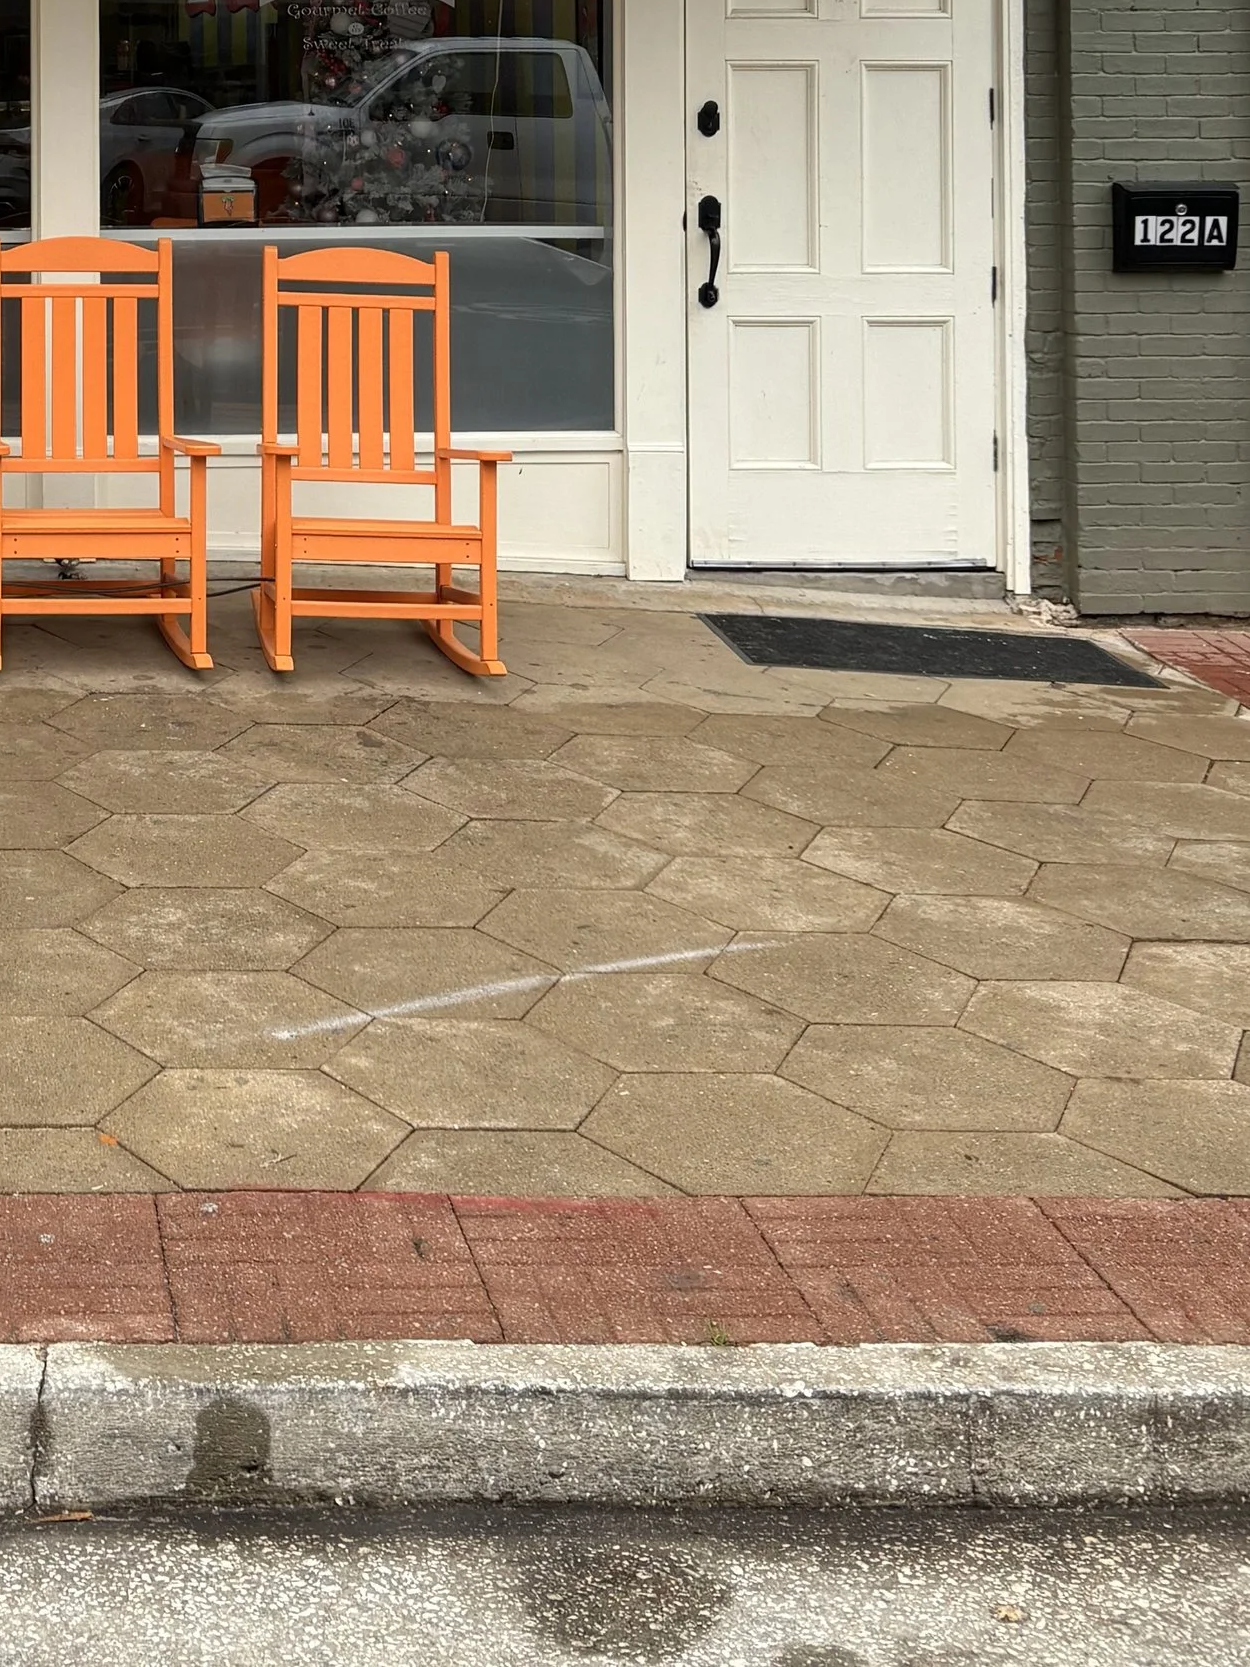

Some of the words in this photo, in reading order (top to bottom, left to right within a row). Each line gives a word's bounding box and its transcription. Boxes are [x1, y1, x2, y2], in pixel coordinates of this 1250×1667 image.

[286, 2, 365, 20] Gourmet
[370, 2, 428, 17] Coffee
[361, 35, 407, 51] Treat
